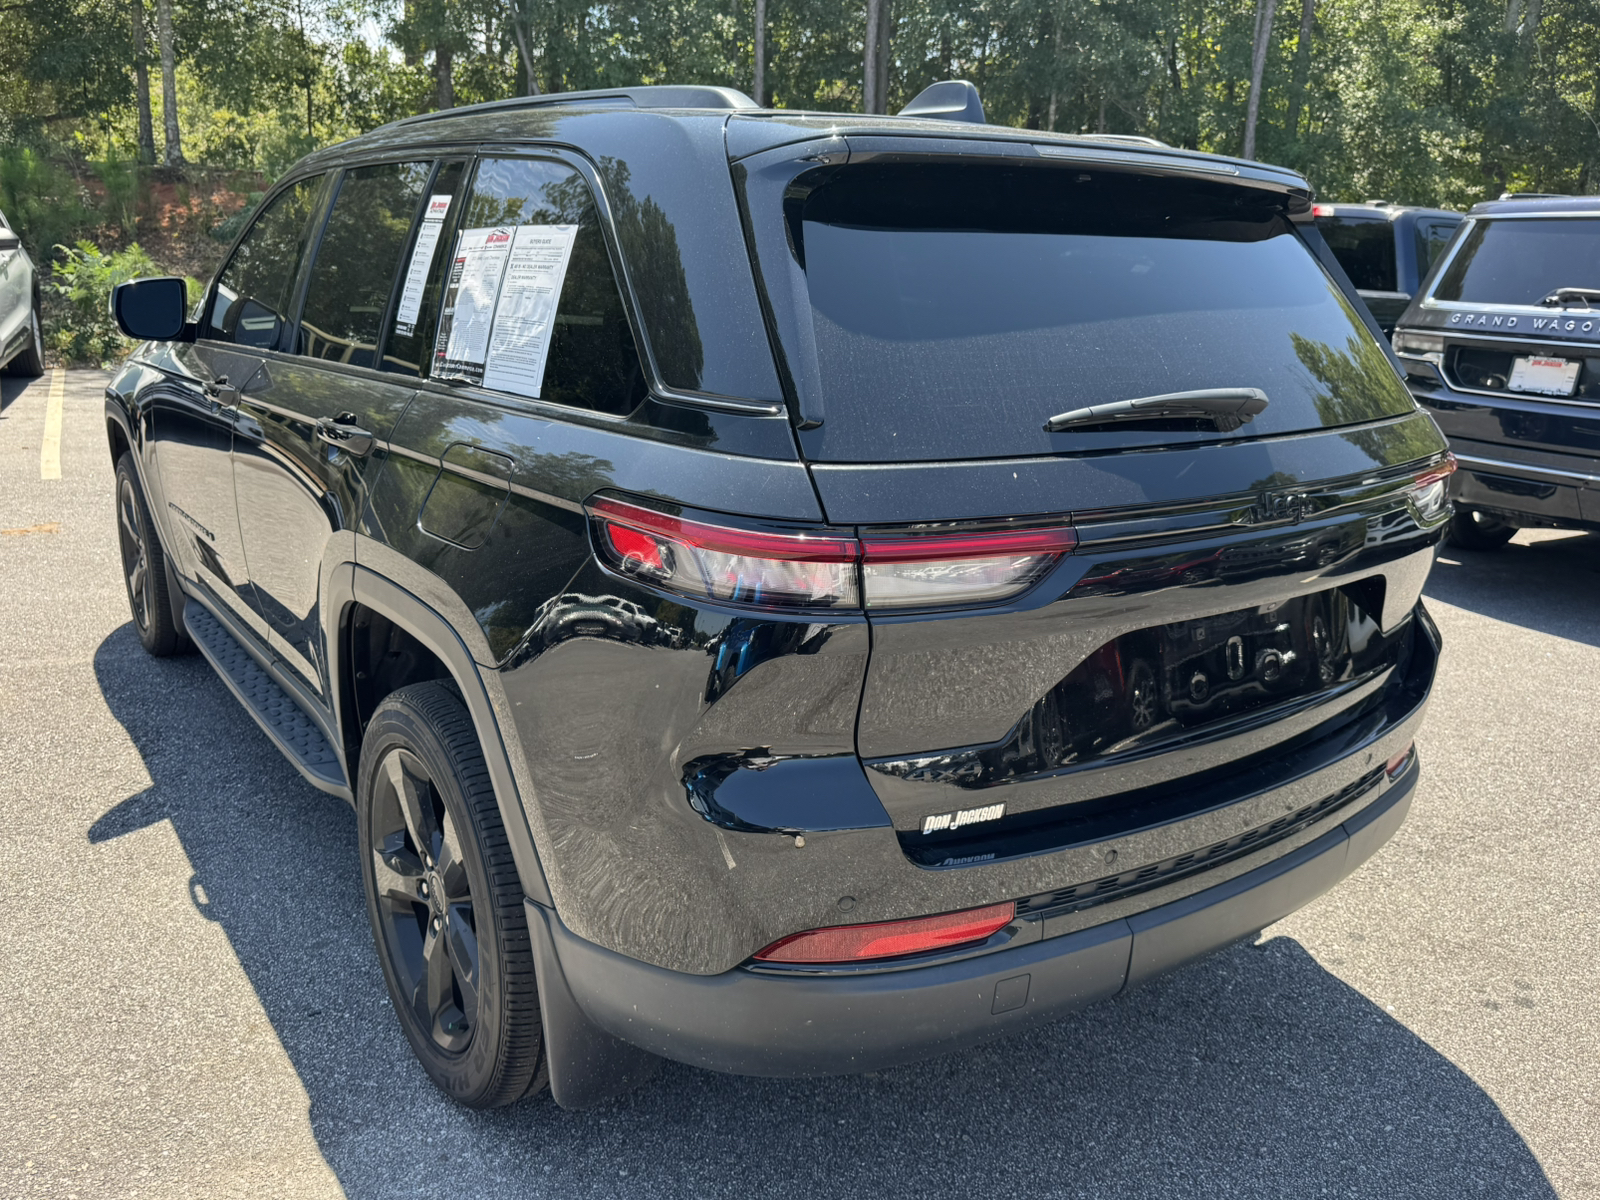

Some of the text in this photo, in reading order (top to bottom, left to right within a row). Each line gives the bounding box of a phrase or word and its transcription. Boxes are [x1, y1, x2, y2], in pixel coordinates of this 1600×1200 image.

[1451, 313, 1600, 334] GRAND WAGO
[1257, 491, 1314, 522] Jeep
[923, 804, 1005, 835] DON JACKSON
